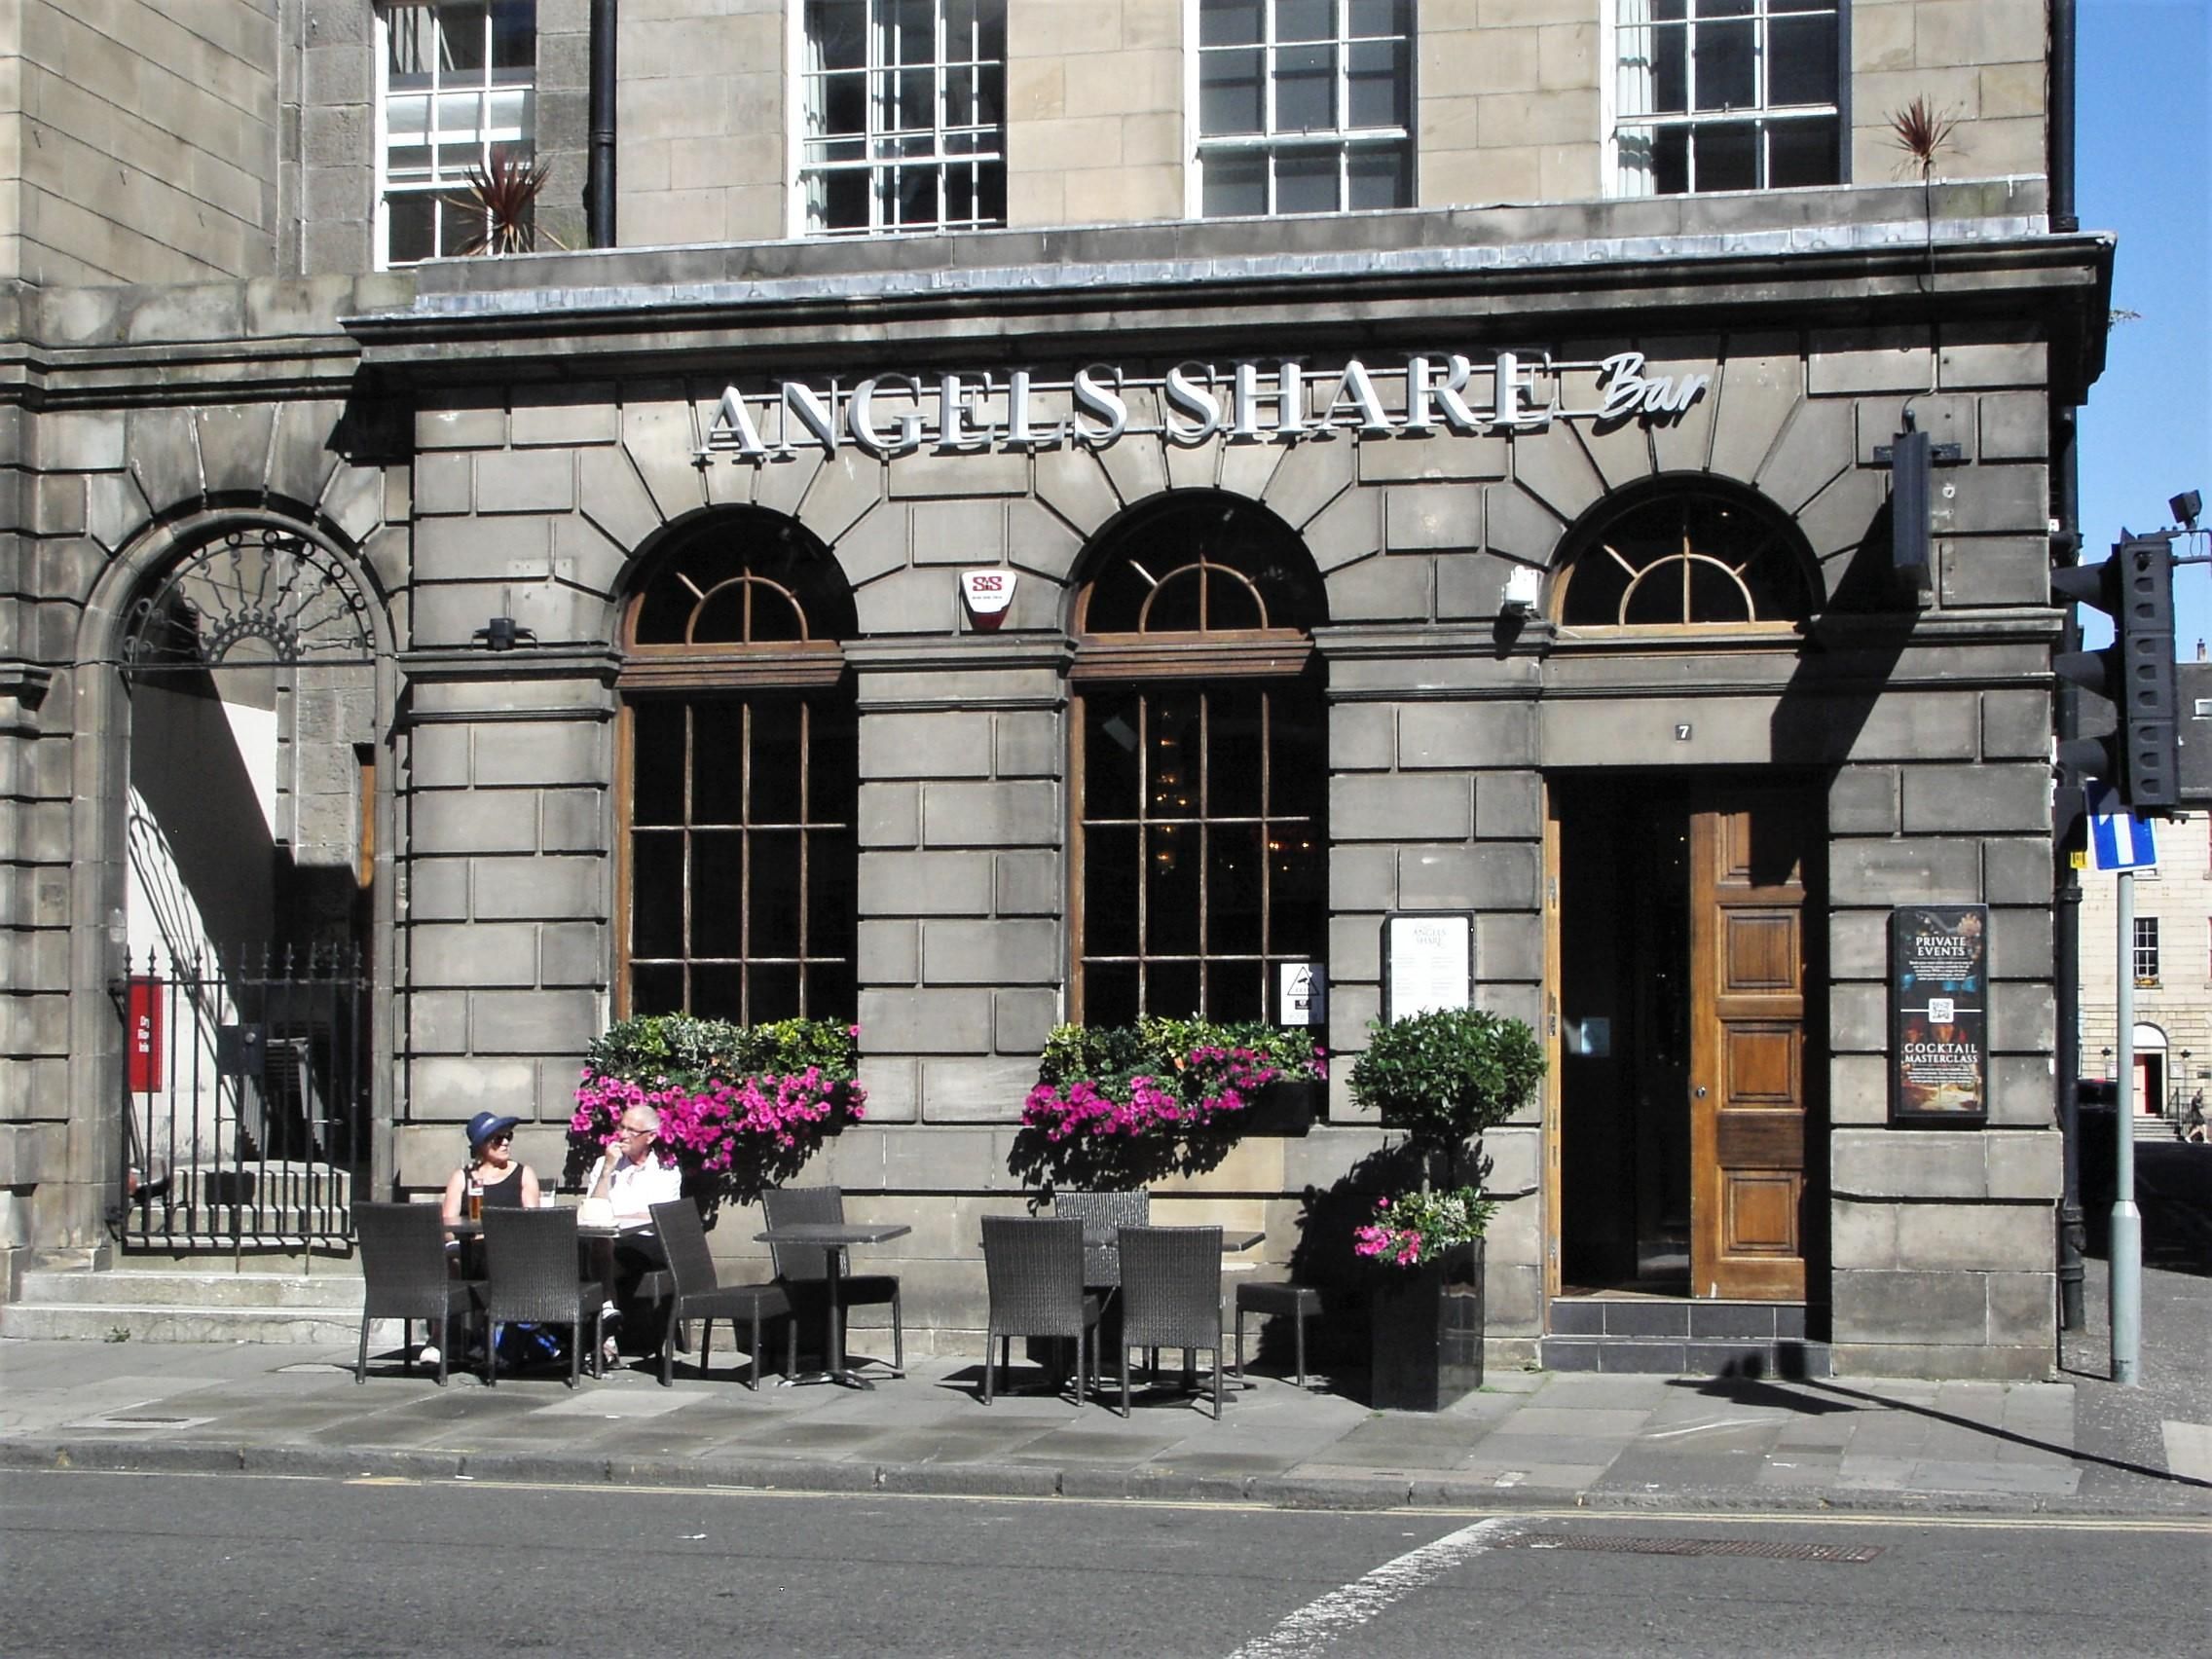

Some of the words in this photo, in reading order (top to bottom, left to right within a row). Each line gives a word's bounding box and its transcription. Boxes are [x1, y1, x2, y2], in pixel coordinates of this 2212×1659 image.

[693, 362, 1128, 457] ANGELS
[1165, 349, 1558, 439] SHARE
[1598, 351, 1711, 421] Bar
[1678, 724, 1690, 739] 7
[1915, 936, 1967, 947] PRIVATE
[1917, 946, 1966, 957] EVENTS
[1904, 1043, 1978, 1054] COCKTAIL
[1903, 1053, 1978, 1064] MASTERCLASS
